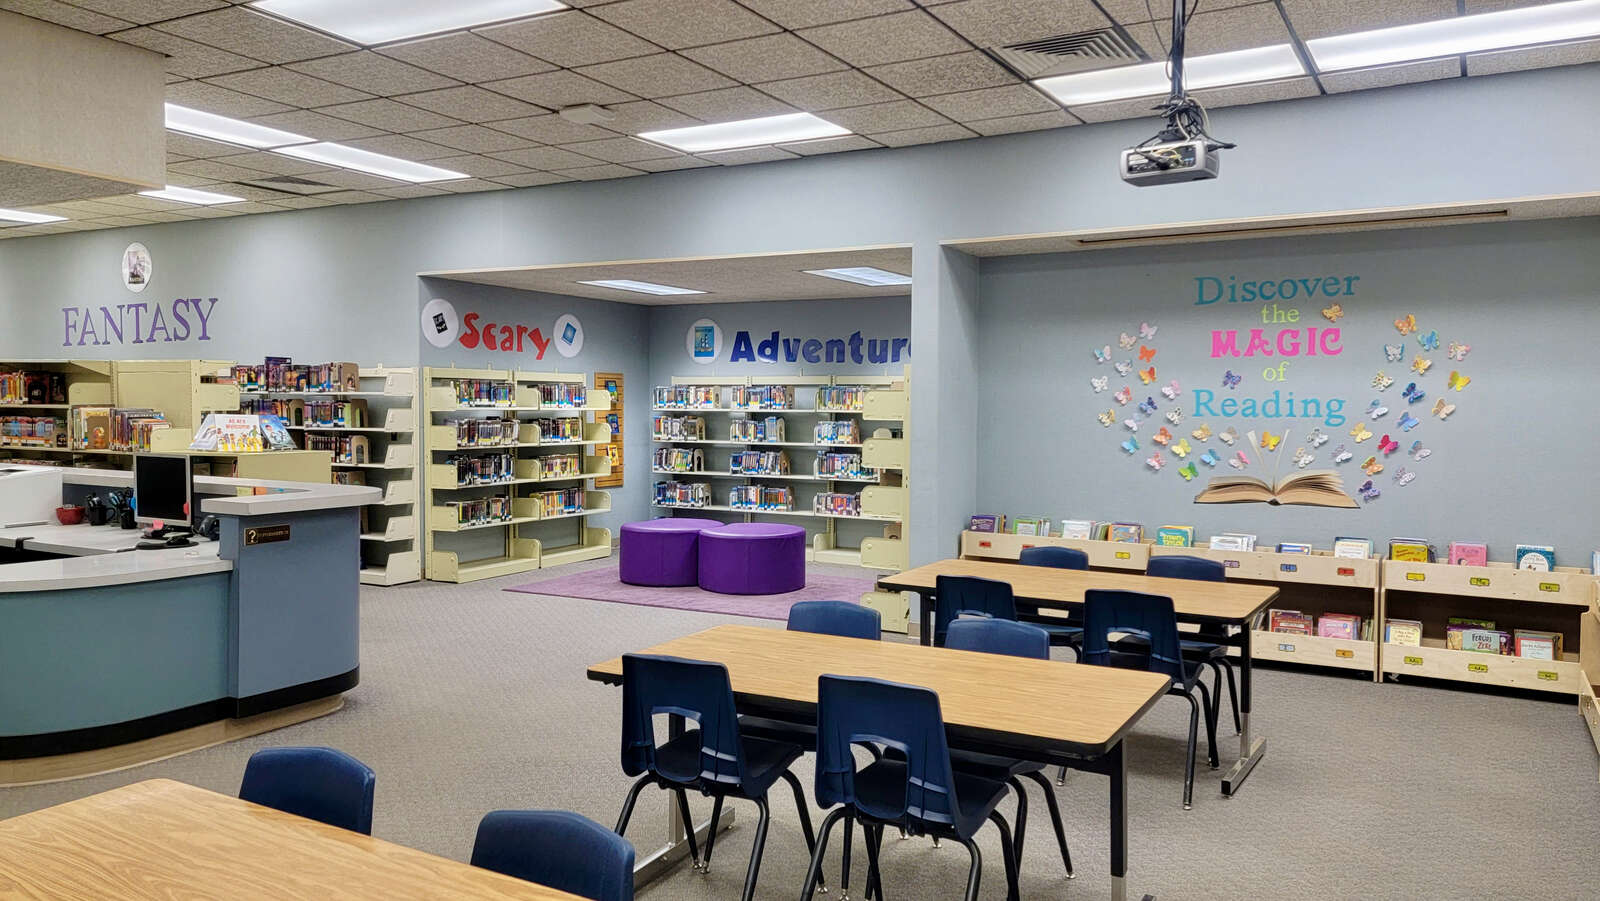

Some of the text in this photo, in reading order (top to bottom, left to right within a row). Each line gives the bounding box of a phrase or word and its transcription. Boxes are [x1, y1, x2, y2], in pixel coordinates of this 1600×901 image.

[1193, 275, 1360, 306] Discover
[62, 298, 218, 347] FANTASY
[1261, 304, 1300, 324] the
[458, 312, 551, 361] Scary
[729, 330, 911, 365] Adventur
[1210, 327, 1344, 359] MAGIC
[1262, 361, 1289, 382] of
[1192, 389, 1347, 428] Reading
